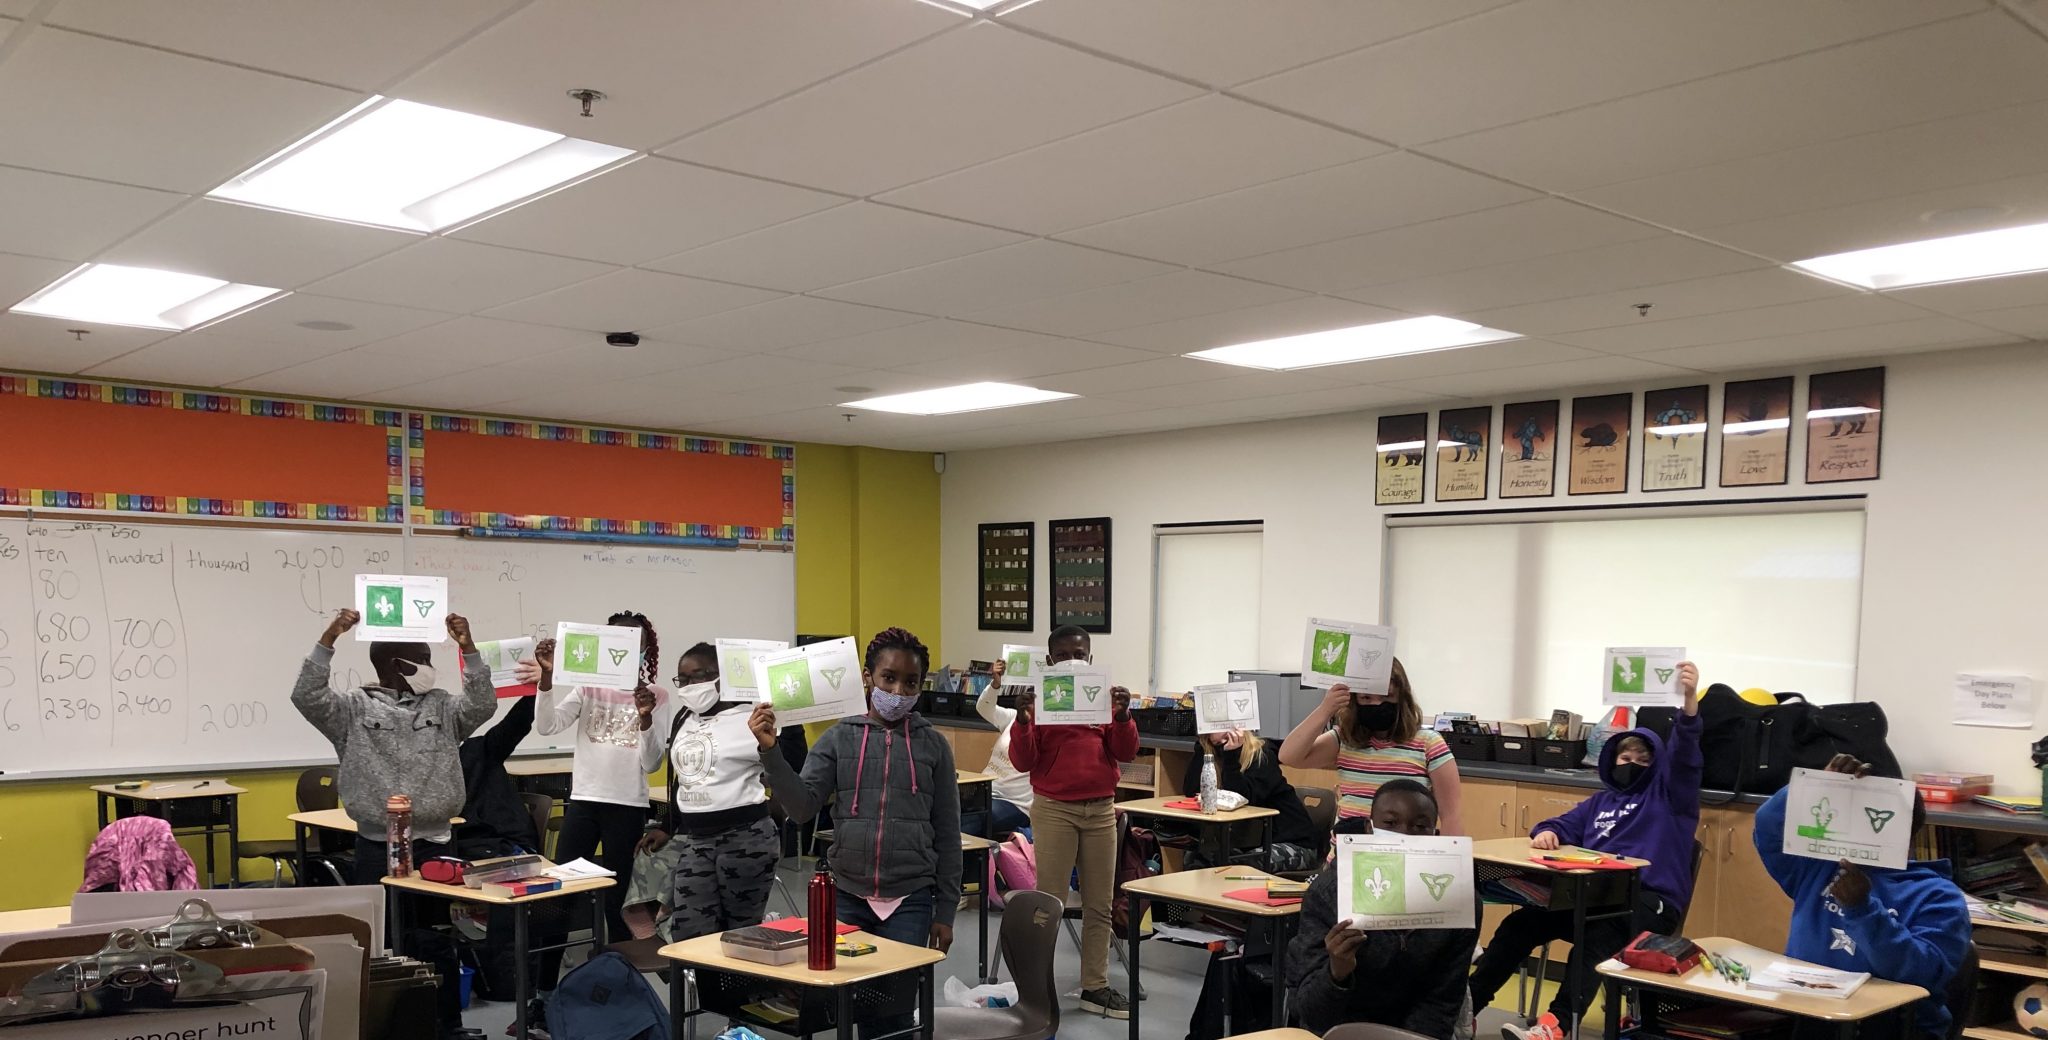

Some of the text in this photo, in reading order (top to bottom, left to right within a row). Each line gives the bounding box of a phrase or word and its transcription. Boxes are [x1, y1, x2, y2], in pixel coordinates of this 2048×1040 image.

[1740, 466, 1767, 474] Love
[1819, 459, 1868, 473] Respect
[1580, 475, 1615, 485] Wisdom
[1659, 468, 1687, 481] Truth
[1446, 481, 1479, 493] Humility
[1510, 479, 1548, 490] Honesty
[1382, 488, 1417, 499] Courage
[111, 528, 141, 539] 650
[34, 540, 68, 563] ten
[106, 548, 164, 564] hundred
[186, 549, 250, 573] thousand
[39, 569, 81, 599] 80
[36, 609, 91, 643] 680
[114, 618, 175, 649] 700
[41, 650, 96, 683] 650
[112, 649, 177, 681] 600
[44, 697, 101, 722] 2390
[117, 691, 172, 716] 2400
[218, 1017, 276, 1037] hunt
